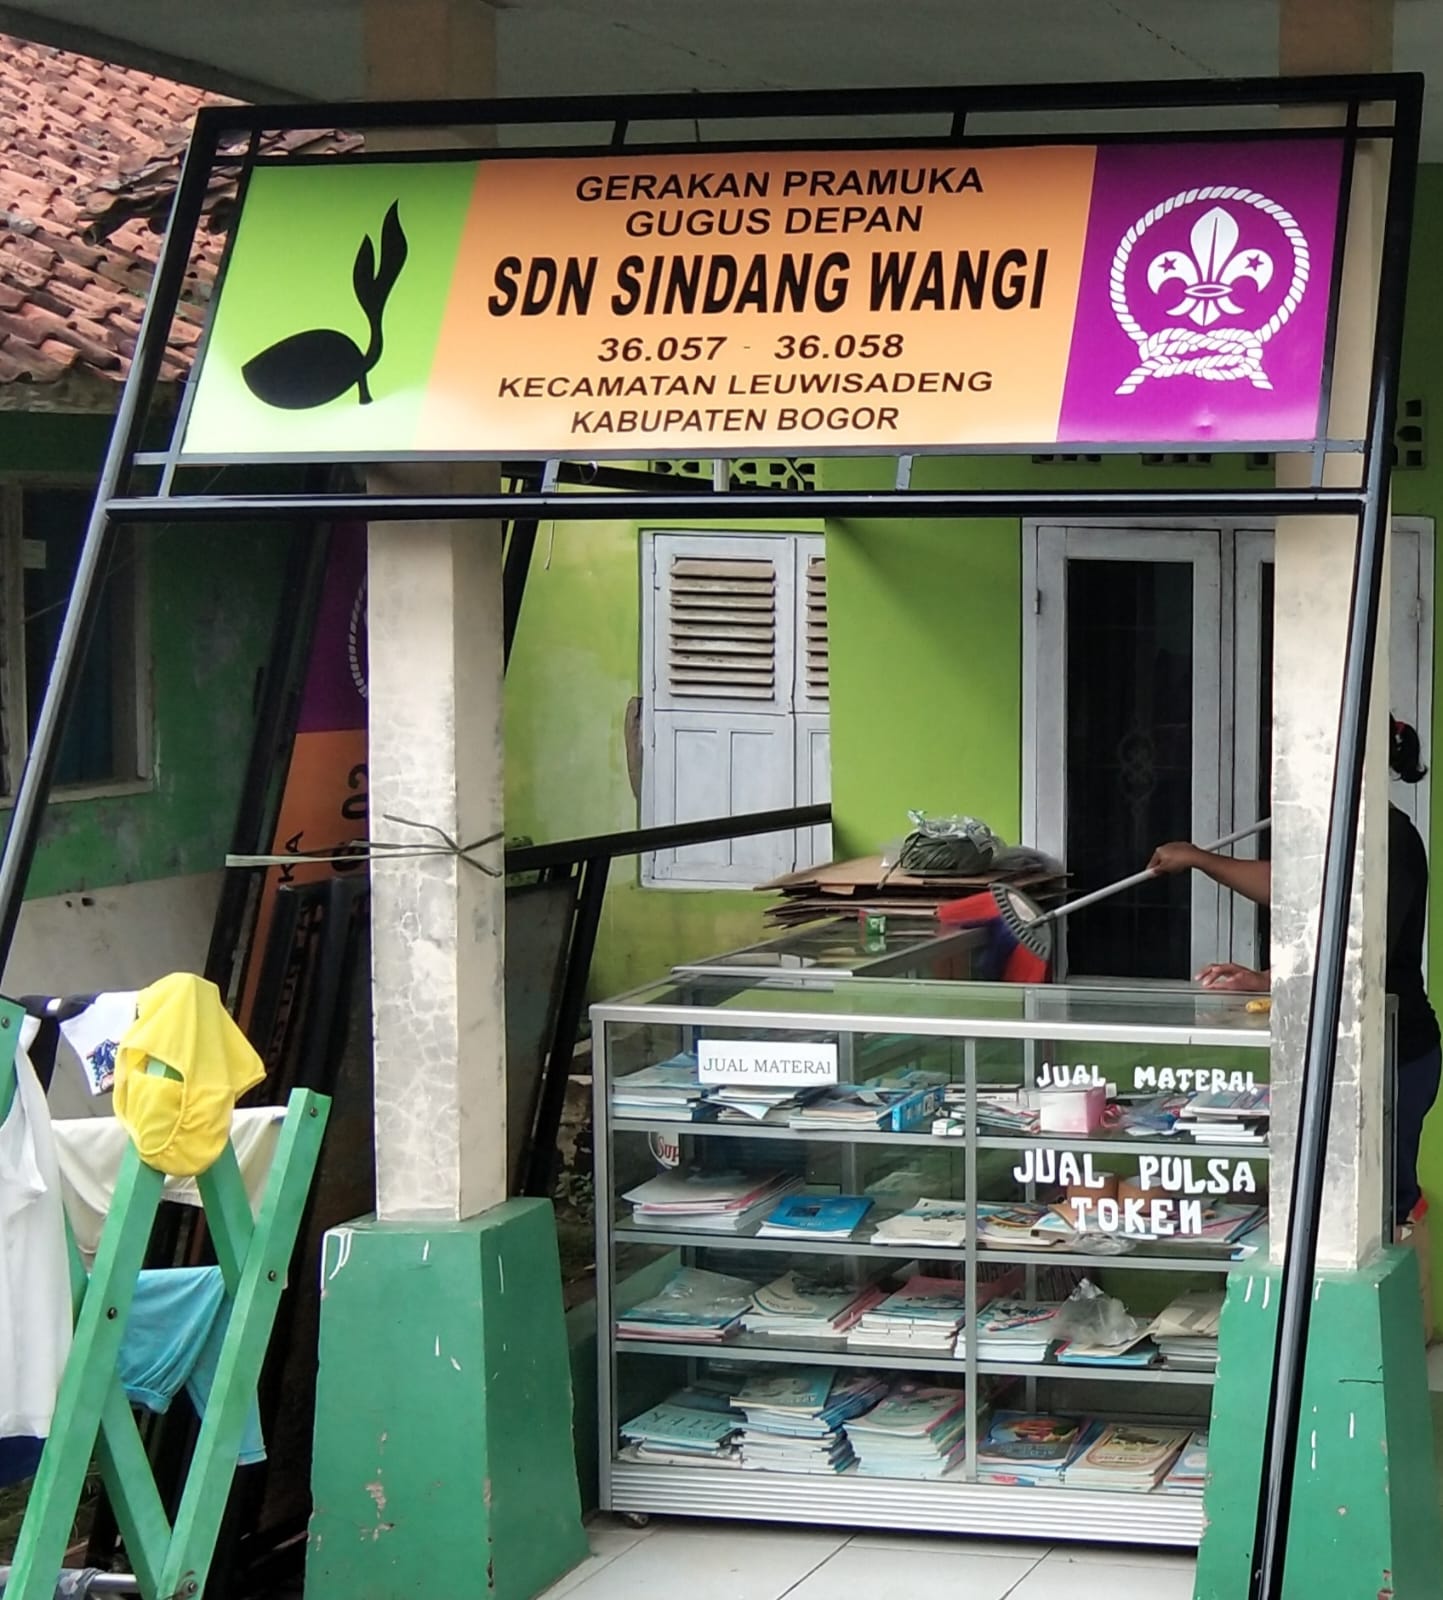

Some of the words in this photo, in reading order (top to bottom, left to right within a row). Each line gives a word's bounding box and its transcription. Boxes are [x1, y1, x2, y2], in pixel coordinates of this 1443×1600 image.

[575, 171, 770, 202] GERAKAN
[782, 166, 984, 197] PRAMUKA
[625, 207, 771, 237] GUGUS
[785, 205, 923, 234] DEPAN
[488, 256, 598, 317] SDN
[610, 251, 851, 316] SINDANG
[869, 248, 1048, 312] WANGI
[597, 336, 728, 362] 36.057
[773, 334, 905, 360] 36.058
[498, 375, 717, 398] KECAMATAN
[727, 371, 993, 395] LEUWISADENG
[570, 409, 767, 434] KABUPATEN
[776, 407, 899, 431] BOGOR
[703, 1057, 749, 1073] JUAL
[753, 1058, 832, 1075] MATERAI
[1036, 1062, 1106, 1088] JUAL
[1134, 1065, 1258, 1096] MATERAI
[1013, 1147, 1105, 1189] JUAL
[1138, 1155, 1256, 1195] PULSA
[1070, 1196, 1202, 1235] TOKEN
